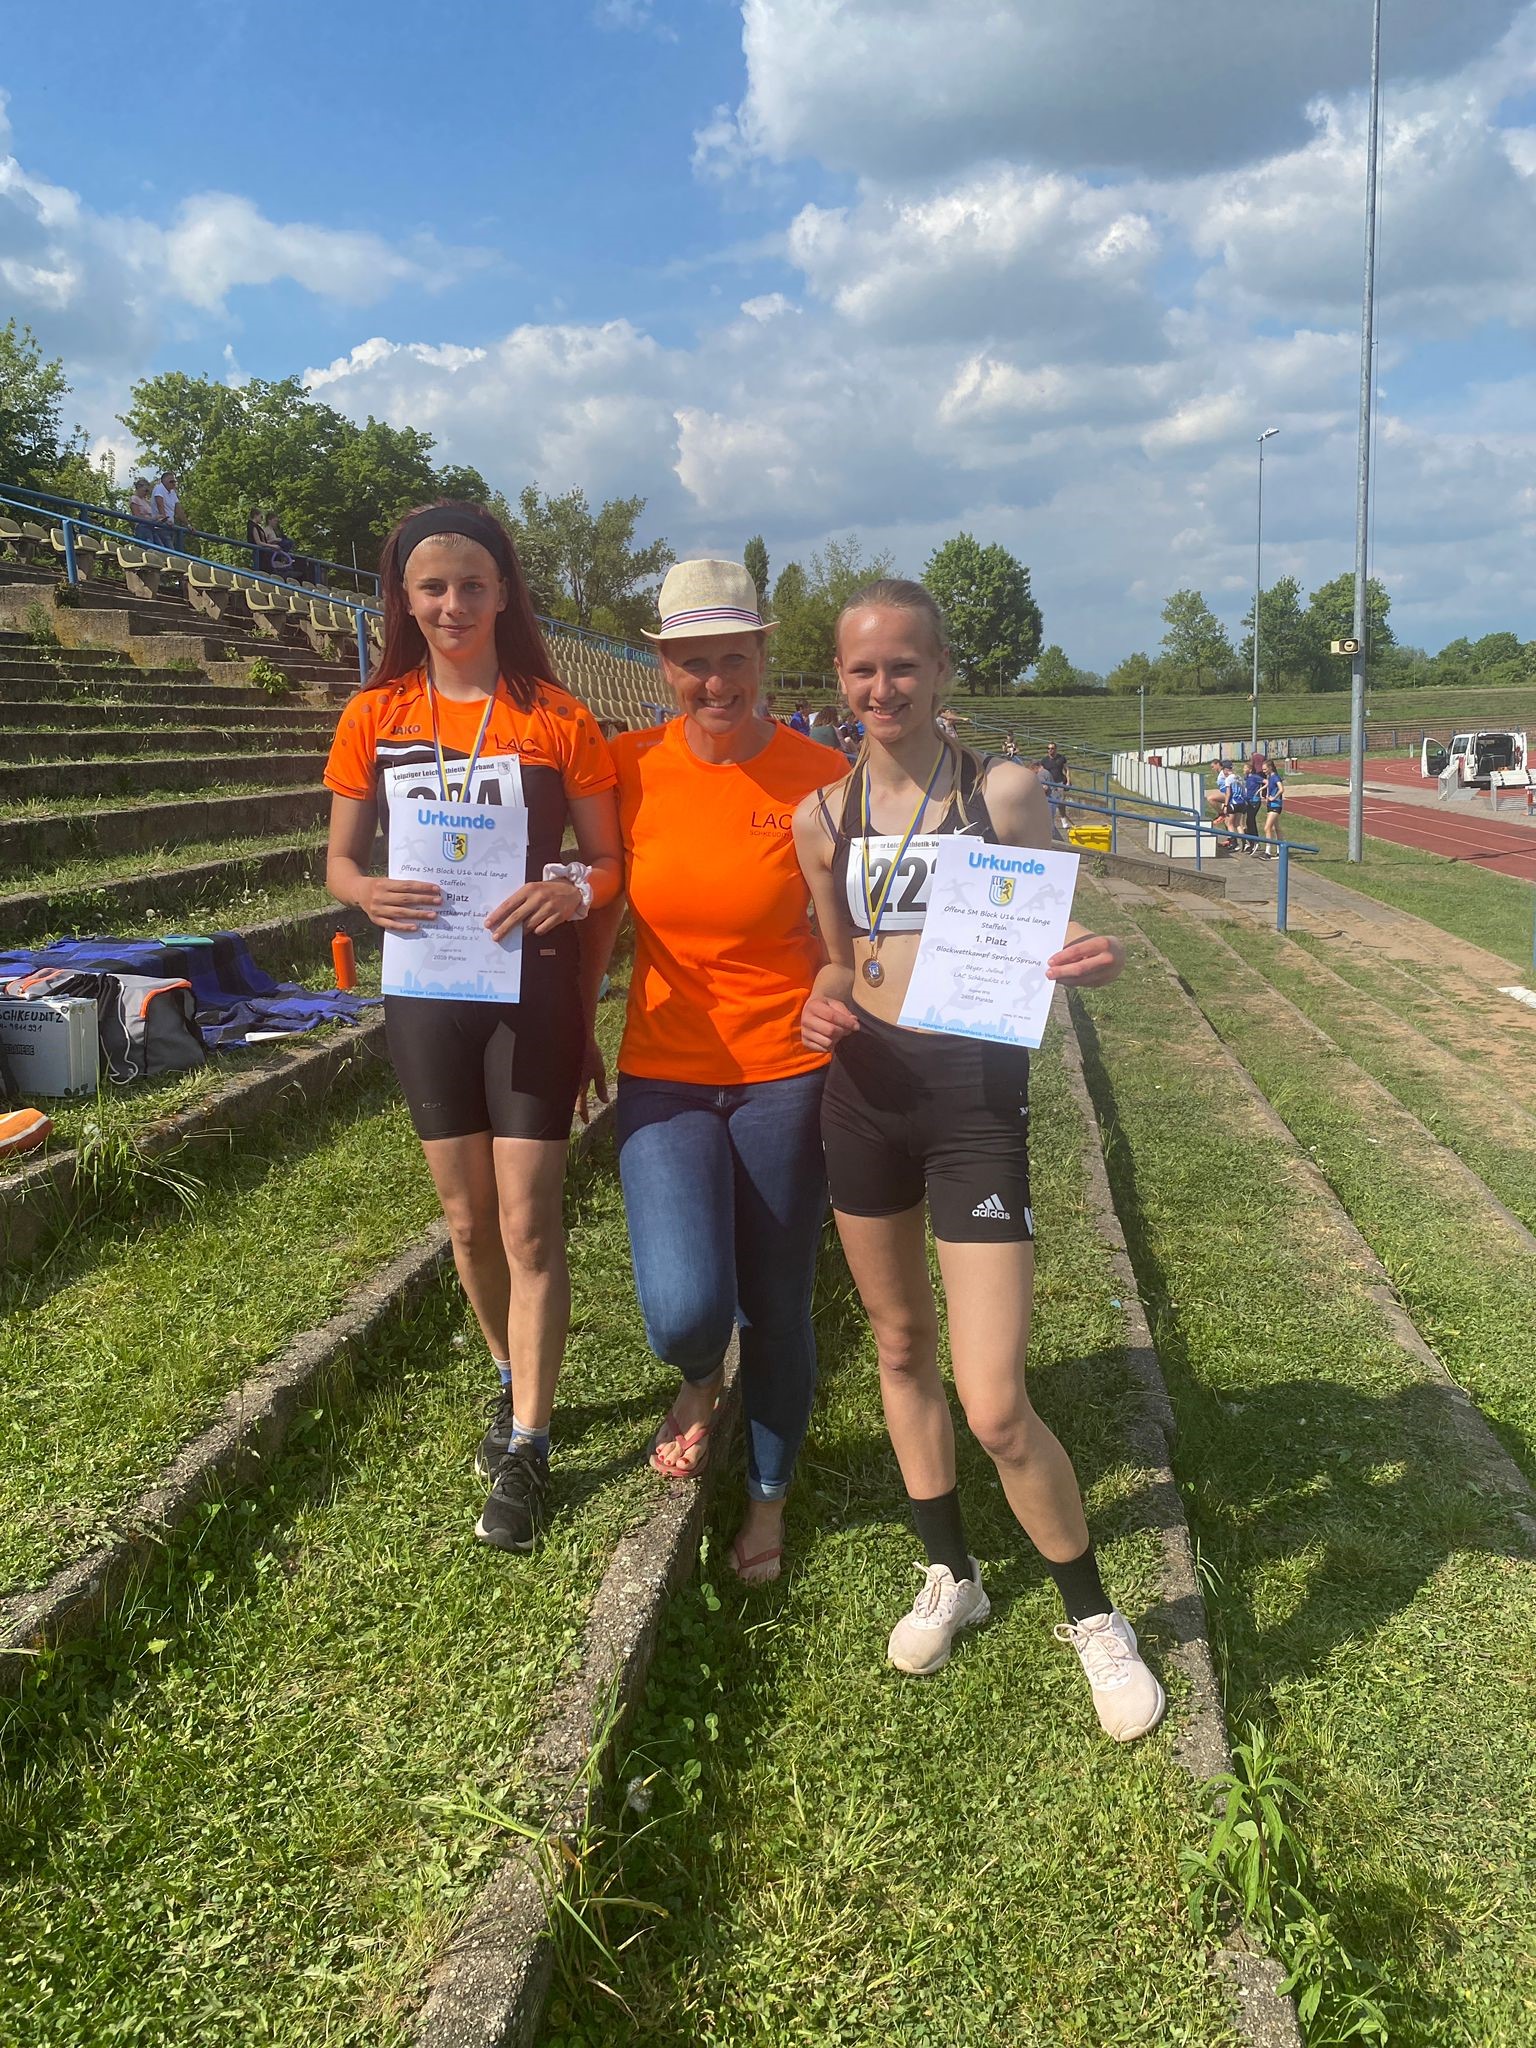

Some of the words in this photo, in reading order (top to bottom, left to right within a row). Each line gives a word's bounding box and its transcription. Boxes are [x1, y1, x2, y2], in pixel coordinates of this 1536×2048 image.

[391, 724, 421, 736] JAKO
[495, 733, 537, 753] LAC
[393, 771, 421, 780] Leipziger
[418, 809, 496, 829] Urkunde
[751, 811, 793, 830] LAC
[401, 864, 421, 872] Offene
[423, 866, 434, 874] SM
[968, 852, 1045, 876] Urkunde
[868, 856, 938, 913] 22
[446, 893, 470, 902] Platz
[944, 905, 966, 914] Offene
[967, 908, 978, 916] SM
[980, 910, 998, 919] Block
[1017, 914, 1031, 922] und
[981, 922, 1007, 931] Staffeln
[975, 935, 983, 943] 1.
[985, 936, 1008, 947] Platz
[936, 945, 990, 959] Blockwettkampf
[972, 1208, 1011, 1220] adidas
